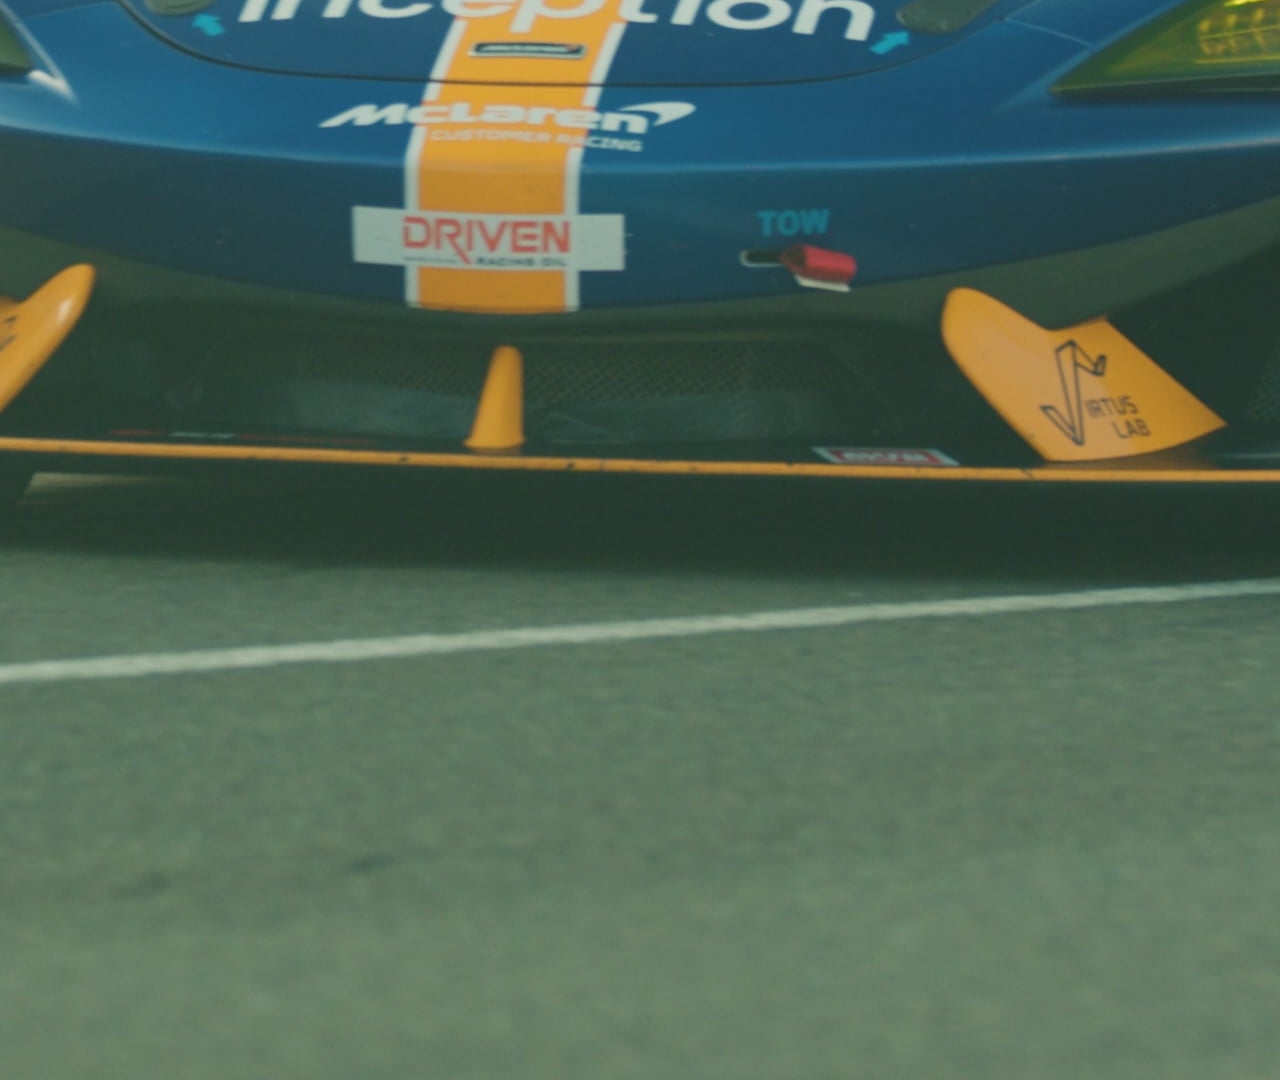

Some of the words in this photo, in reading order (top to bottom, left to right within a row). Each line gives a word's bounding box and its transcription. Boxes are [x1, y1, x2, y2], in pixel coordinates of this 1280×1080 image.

[319, 101, 649, 135] McLaren
[430, 128, 552, 144] CUSTOMER
[555, 133, 643, 152] RACING
[757, 209, 830, 237] TOW
[402, 216, 571, 265] DRIVEN
[1112, 418, 1151, 440] LAB
